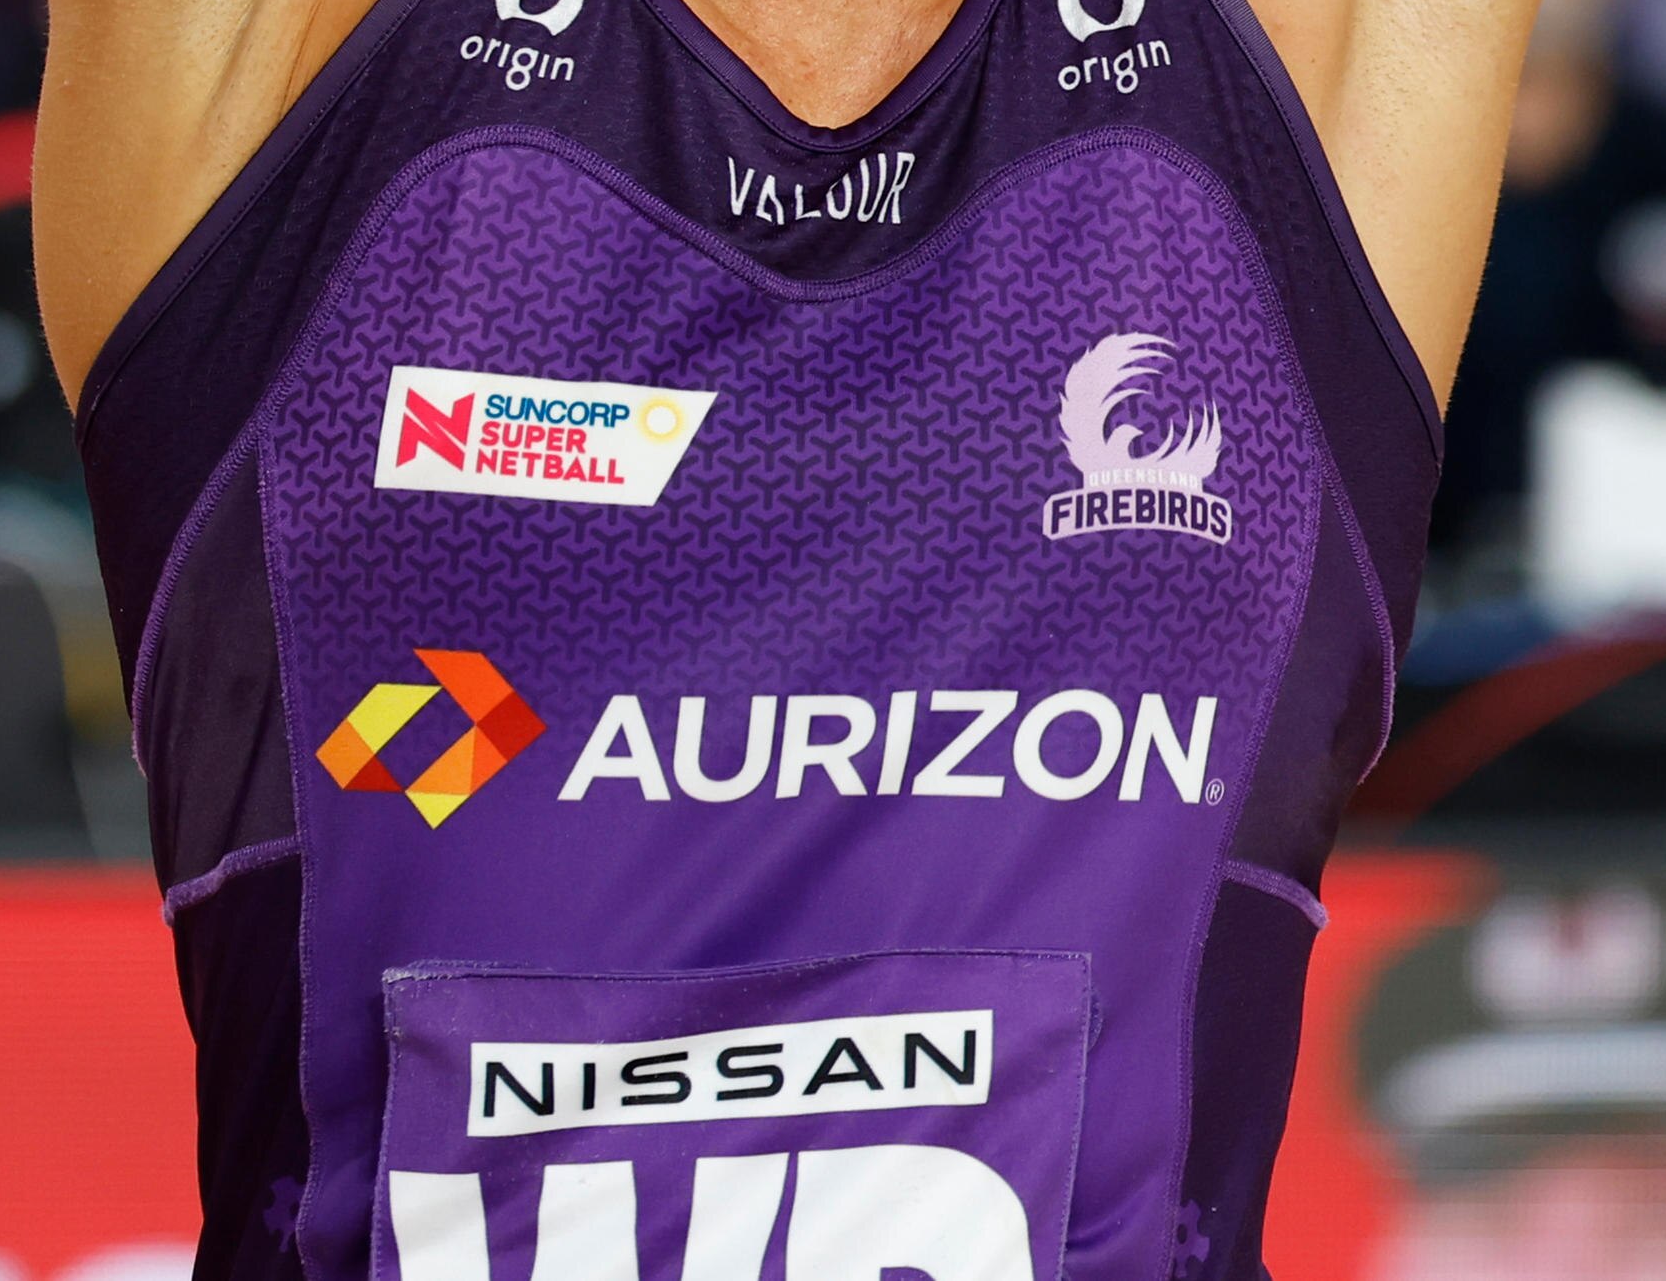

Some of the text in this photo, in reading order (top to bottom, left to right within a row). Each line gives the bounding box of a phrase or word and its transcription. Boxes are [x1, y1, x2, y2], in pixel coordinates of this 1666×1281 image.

[460, 36, 574, 91] origin
[1058, 40, 1171, 93] origin
[727, 152, 916, 225] VALOUR
[484, 394, 630, 428] SUNCORP
[479, 421, 587, 453] SUPER
[475, 449, 625, 484] NETBALL
[1089, 468, 1198, 488] QUEENSLAND
[1050, 489, 1228, 538] FIREBIRDS
[557, 689, 1218, 804] AURIZON
[483, 1029, 976, 1117] NISSAN
